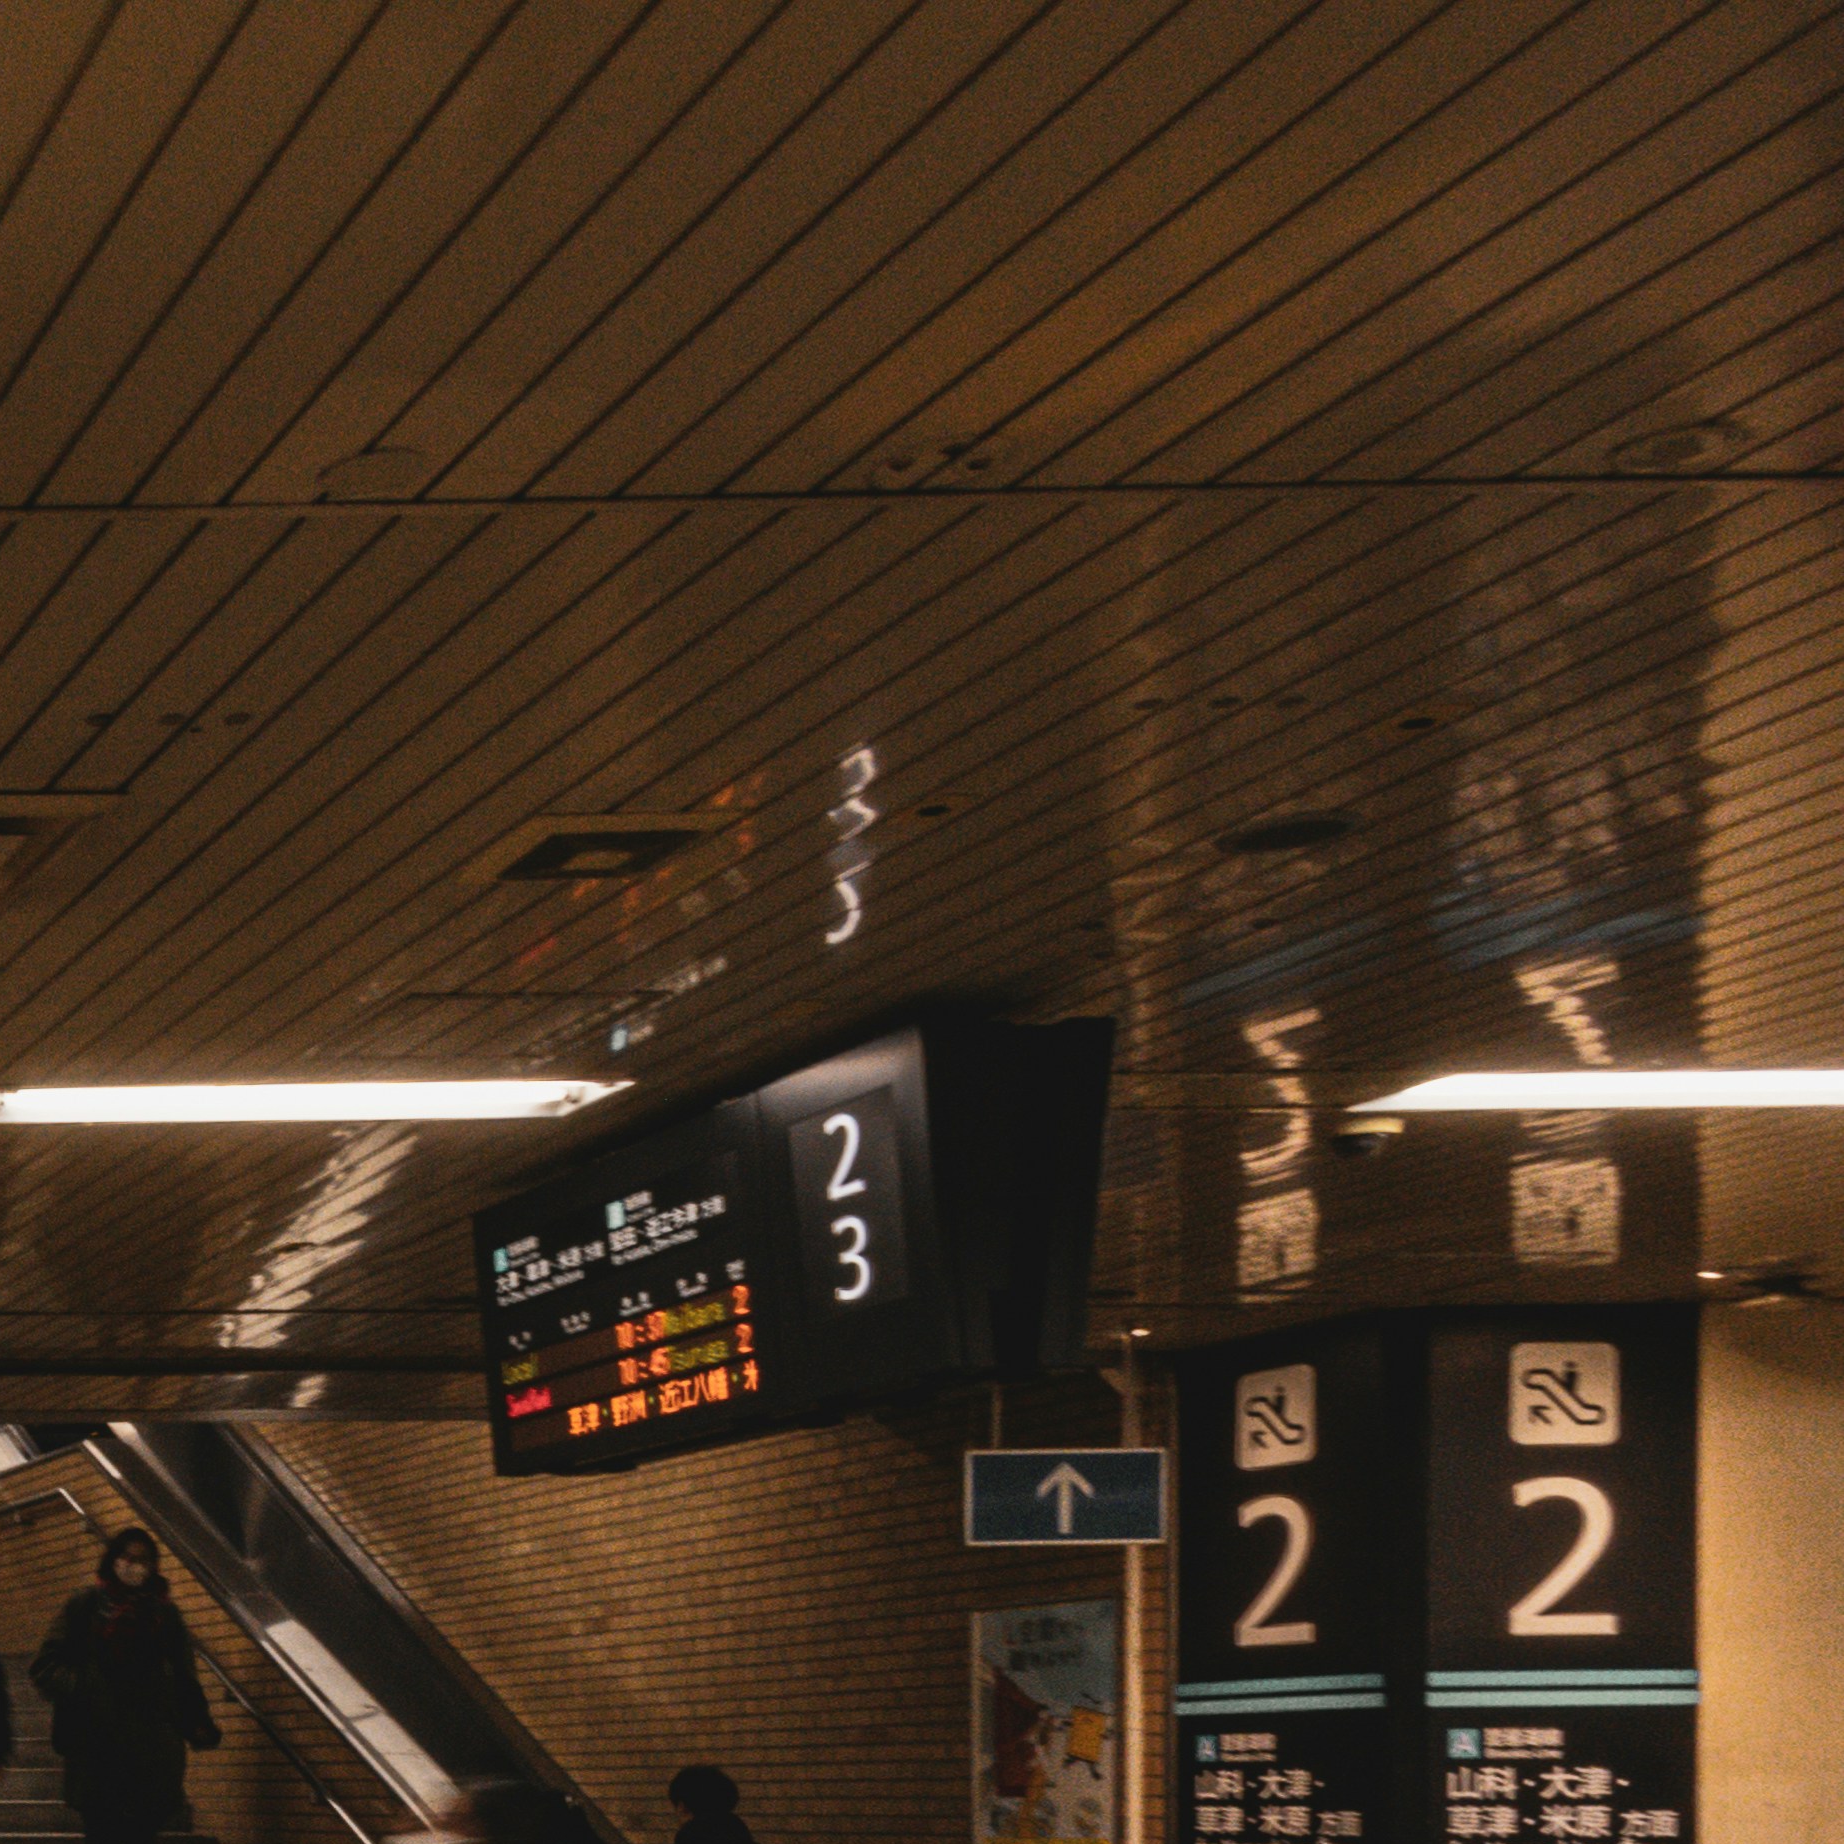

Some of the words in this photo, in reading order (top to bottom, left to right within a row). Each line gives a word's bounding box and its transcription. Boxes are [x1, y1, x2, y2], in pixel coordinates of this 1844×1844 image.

[824, 1113, 865, 1198] 2
[832, 1216, 871, 1299] 3
[1235, 1494, 1314, 1646] 2
[1509, 1477, 1618, 1636] 2
